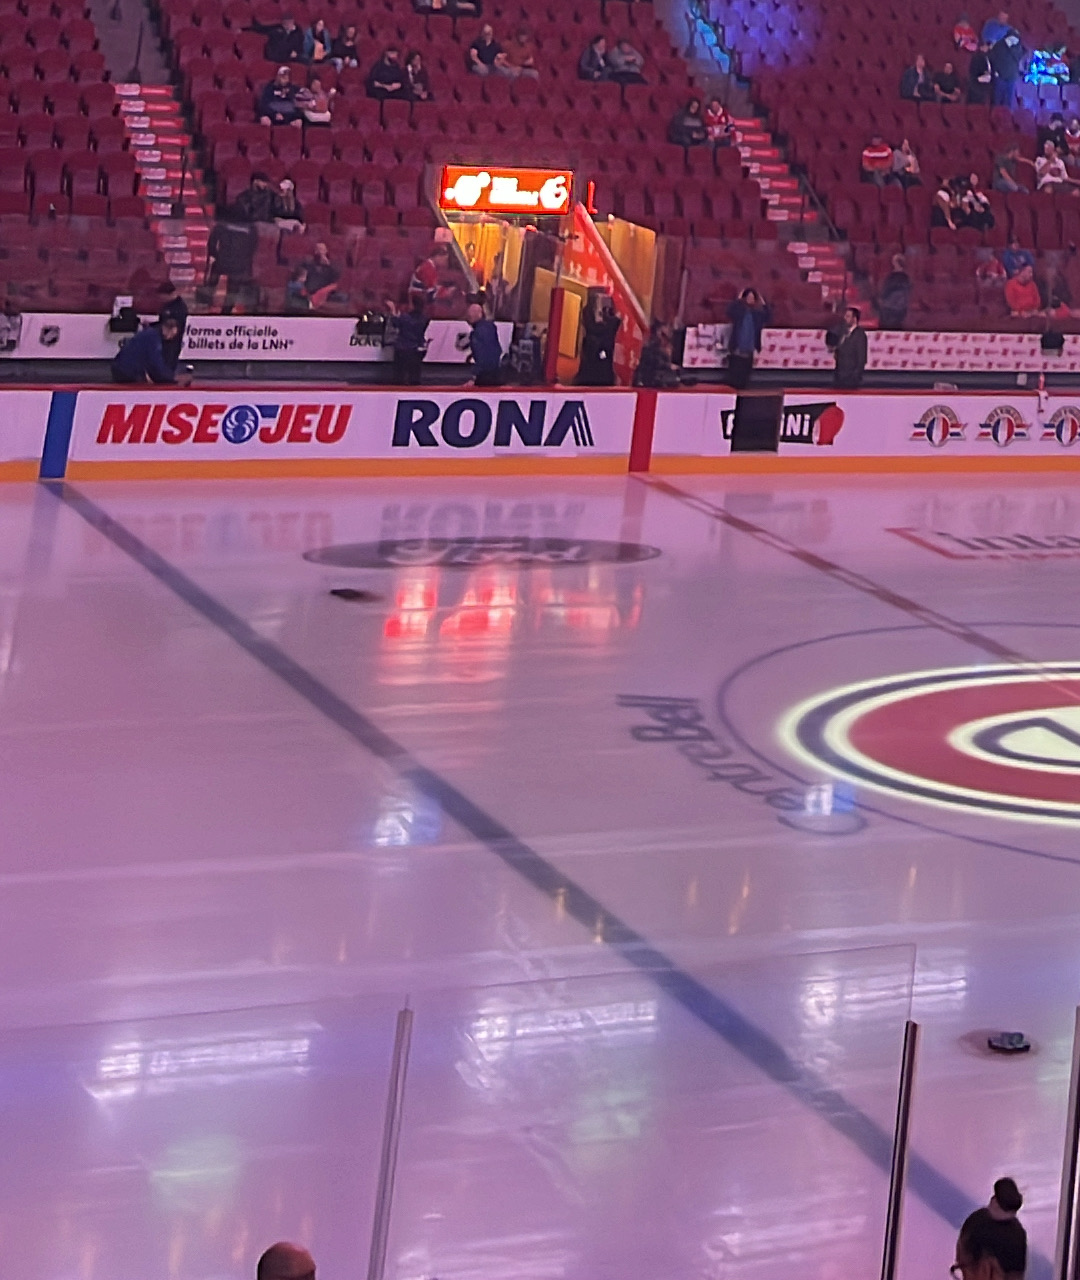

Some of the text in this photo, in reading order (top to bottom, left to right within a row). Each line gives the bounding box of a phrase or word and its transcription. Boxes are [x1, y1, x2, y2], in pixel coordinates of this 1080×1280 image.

[225, 326, 278, 337] officielle
[188, 340, 225, 350] billets
[228, 340, 244, 350] de
[247, 340, 259, 350] la
[392, 400, 594, 448] RONA
